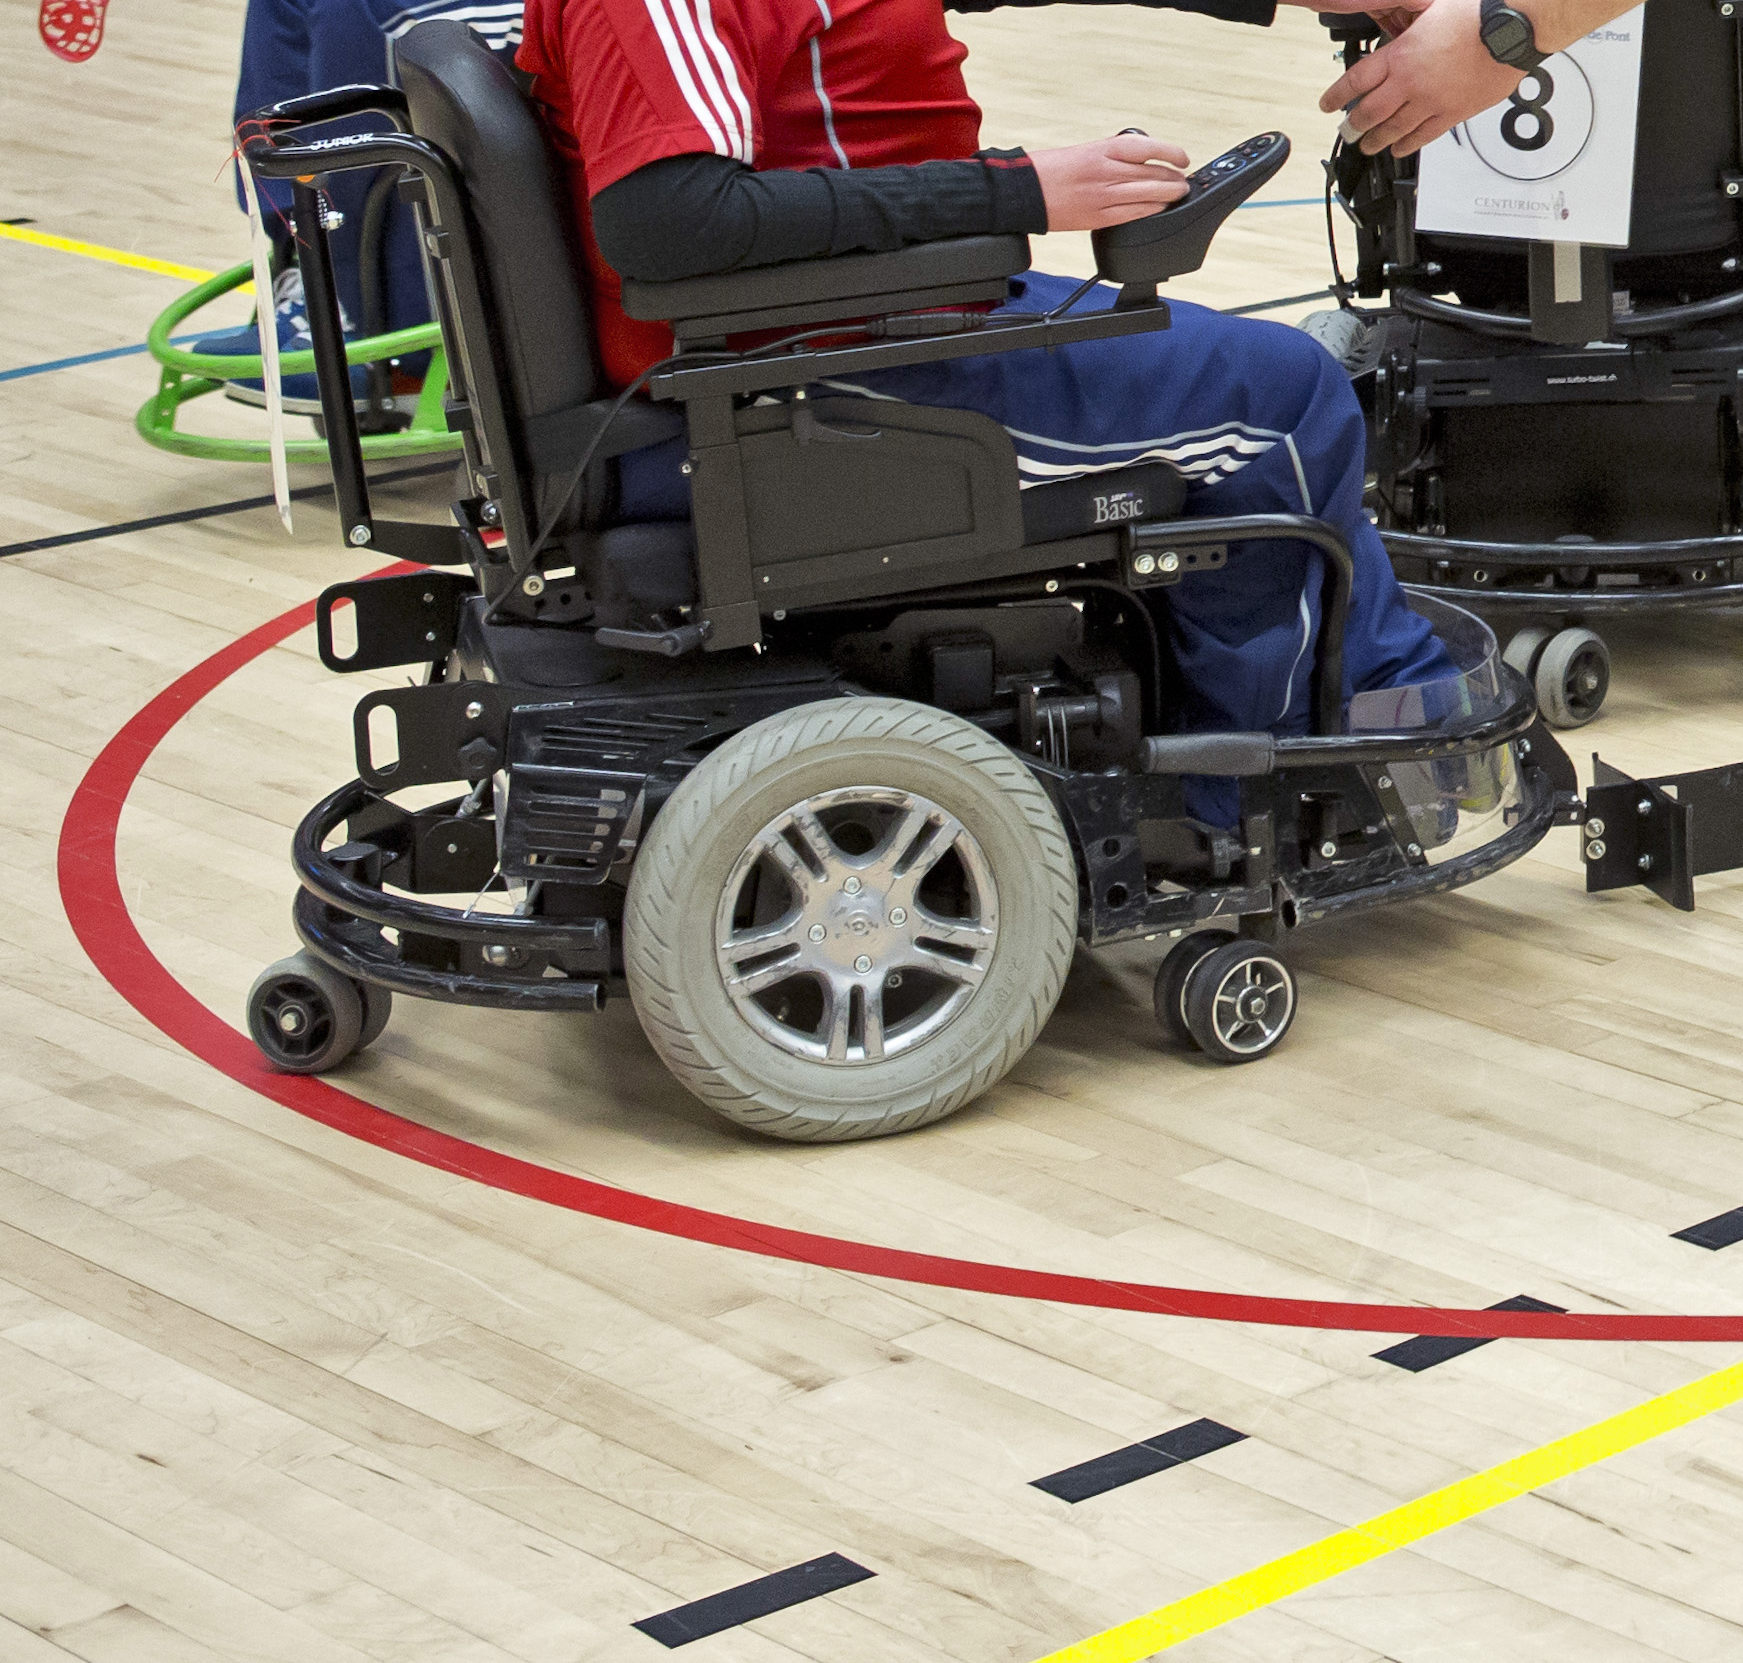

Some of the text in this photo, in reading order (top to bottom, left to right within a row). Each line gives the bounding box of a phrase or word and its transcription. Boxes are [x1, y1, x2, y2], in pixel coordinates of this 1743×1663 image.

[1500, 65, 1554, 151] 8
[310, 132, 374, 150] JUNIOR
[1474, 197, 1550, 211] CENTURION
[1093, 496, 1144, 524] Basic
